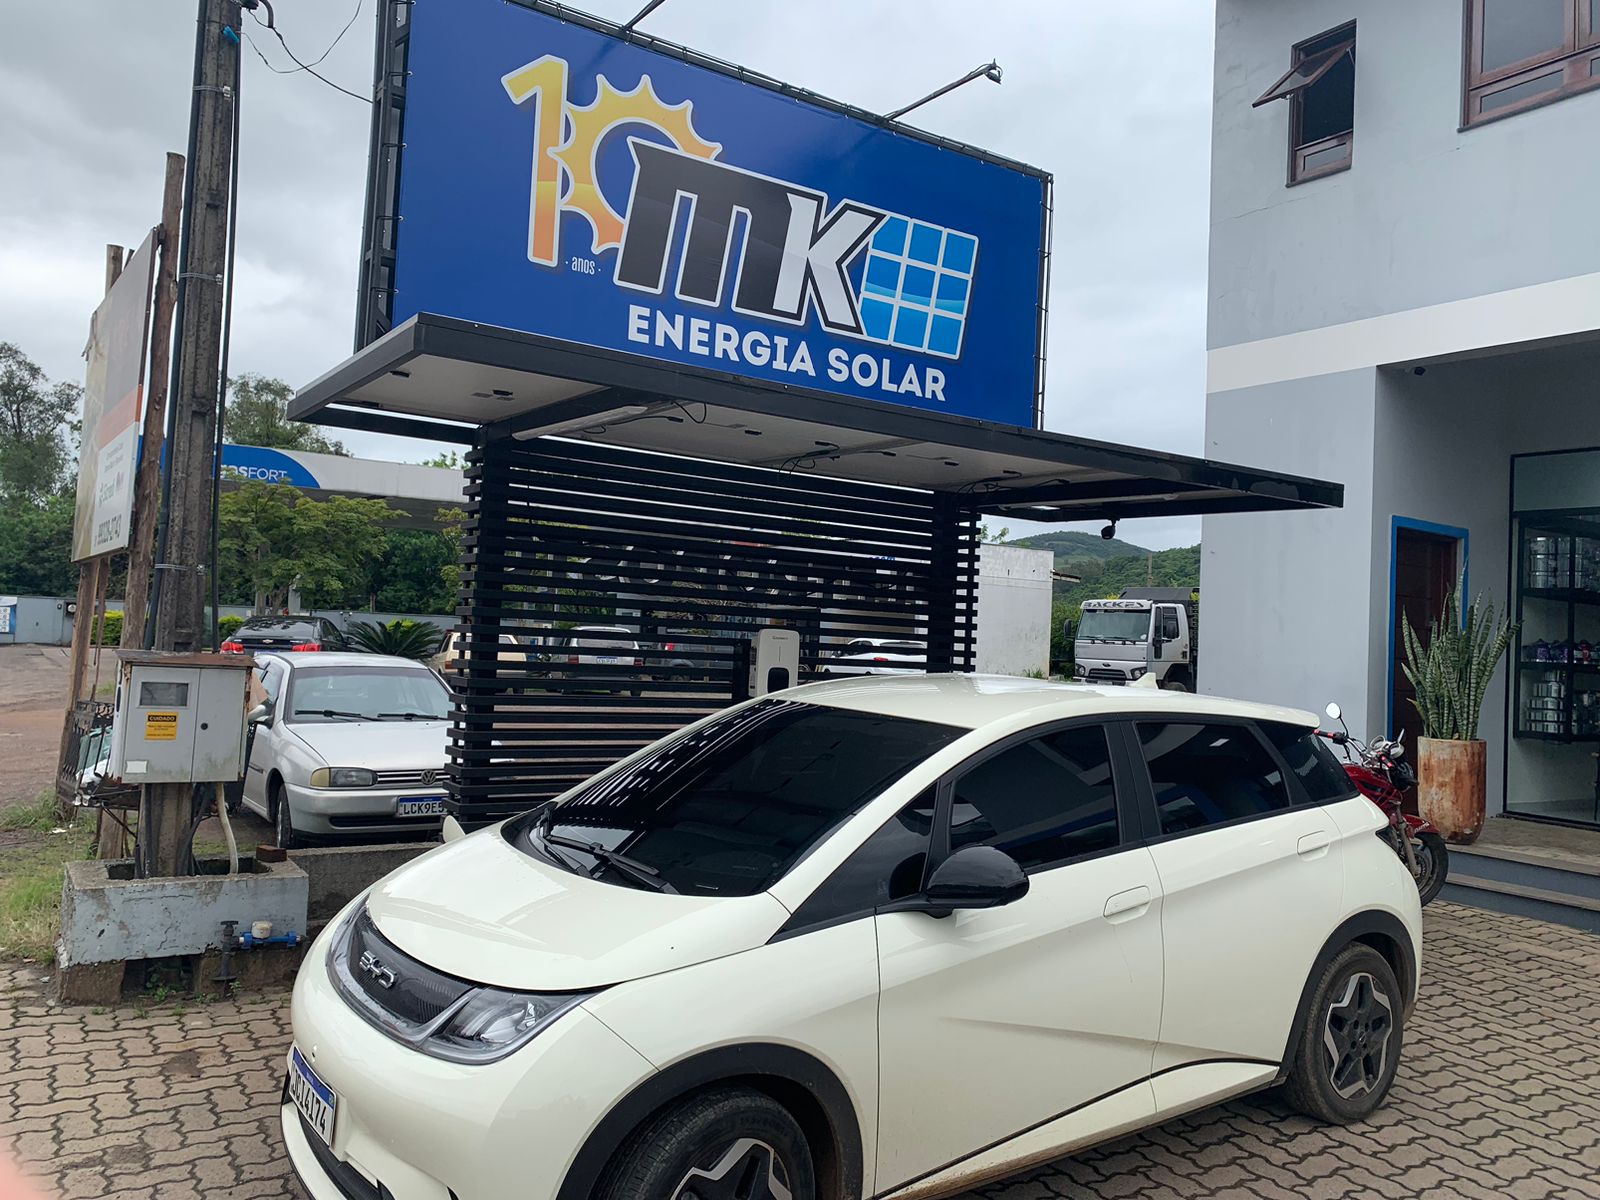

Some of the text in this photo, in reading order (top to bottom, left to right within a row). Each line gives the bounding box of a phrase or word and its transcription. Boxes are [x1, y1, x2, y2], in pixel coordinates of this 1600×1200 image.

[571, 256, 595, 275] anos
[628, 304, 946, 402] ENERGIA SOLAR
